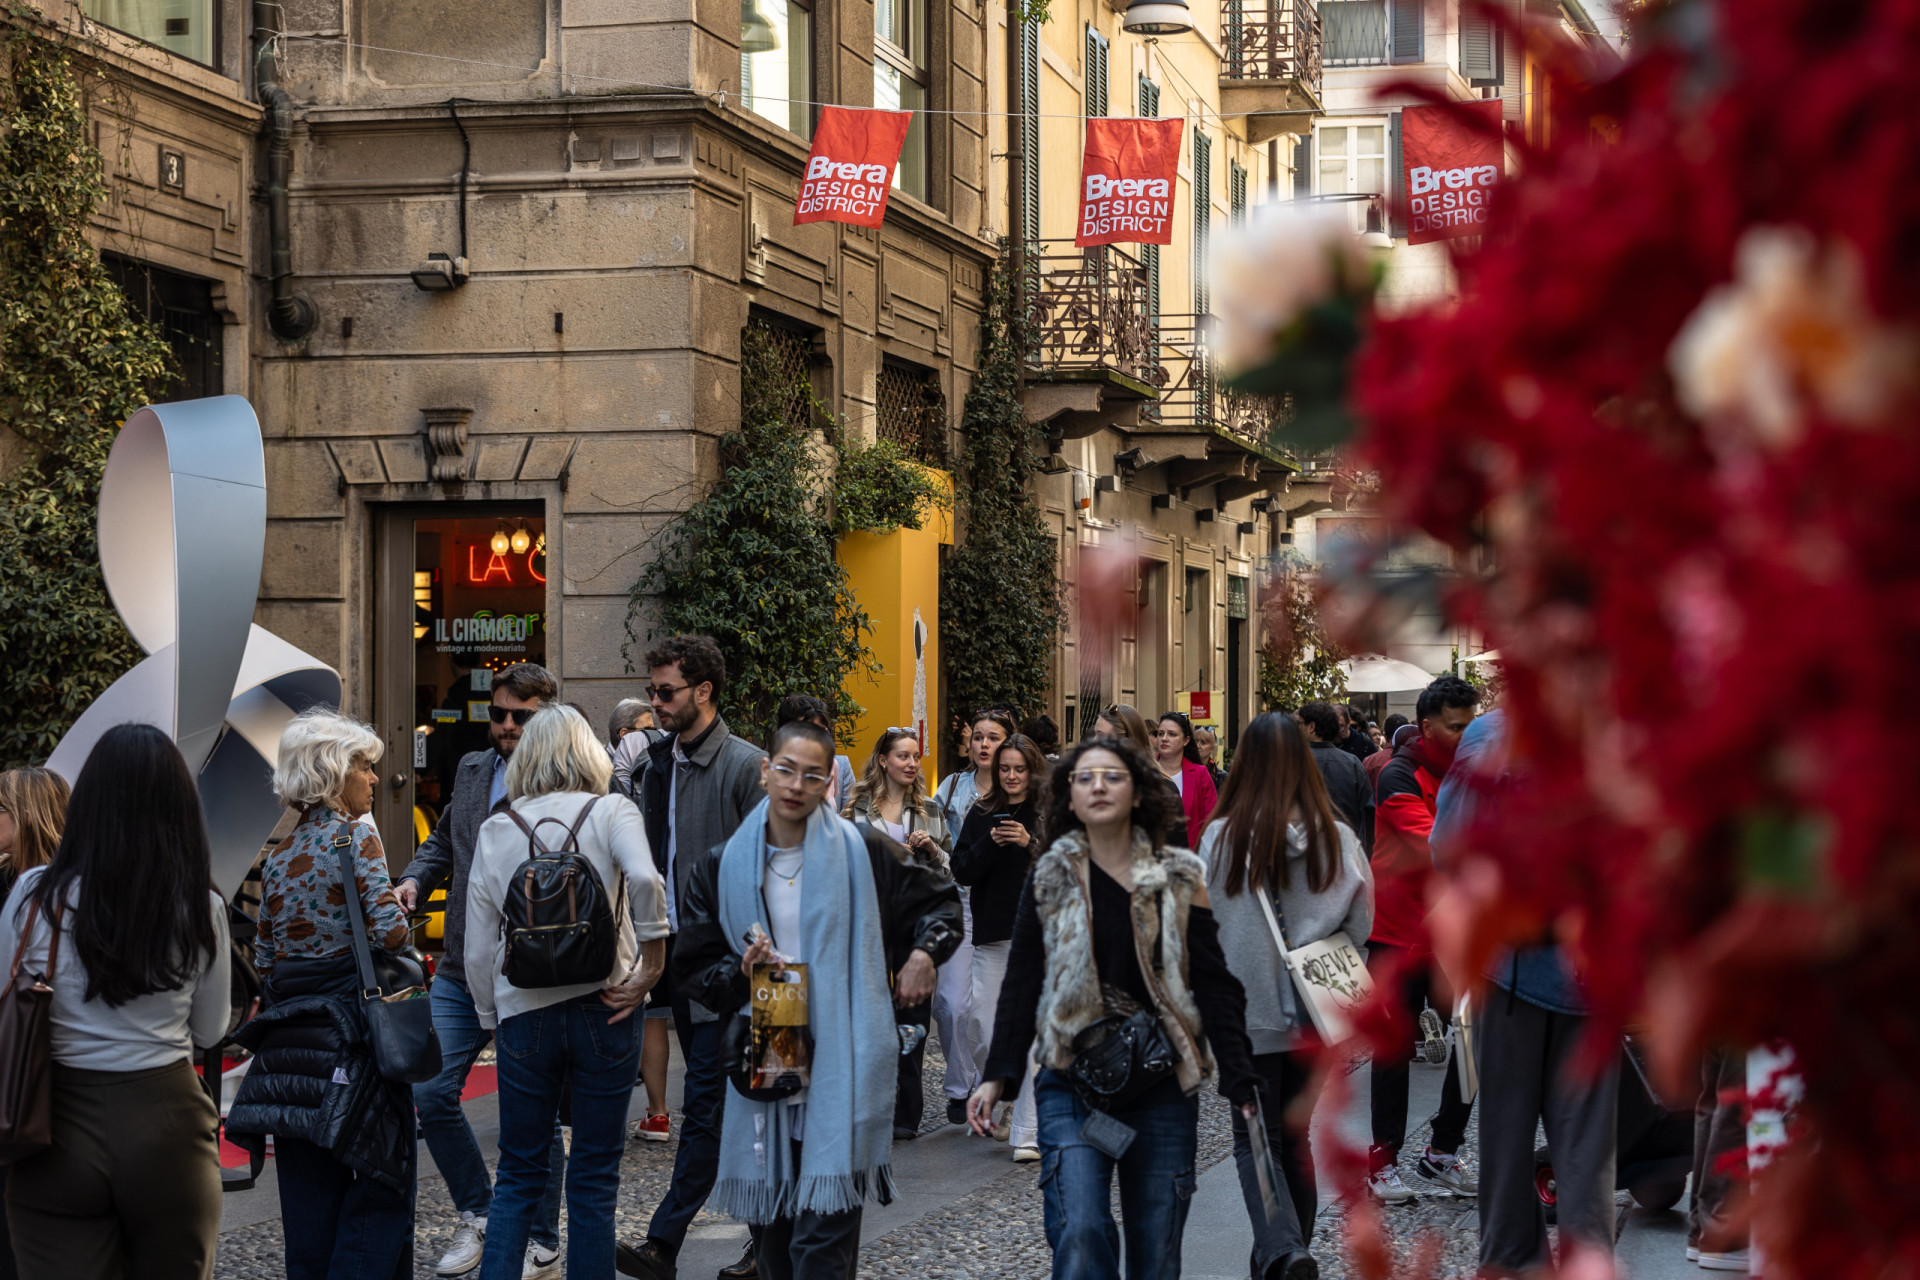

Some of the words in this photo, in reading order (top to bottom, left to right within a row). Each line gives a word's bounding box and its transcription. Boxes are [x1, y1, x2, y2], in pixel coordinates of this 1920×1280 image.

[168, 156, 178, 183] 3
[807, 156, 887, 184] Brera
[1410, 165, 1498, 195] Brera
[802, 181, 883, 201] DESIGN
[1086, 174, 1169, 201] Brera
[798, 196, 880, 216] DISTRICT
[1084, 200, 1168, 220] DESIGN
[1082, 216, 1166, 237] DISTRICT
[1414, 207, 1490, 233] DISTRIC
[469, 545, 512, 582] LA
[435, 617, 450, 642] IL
[452, 617, 526, 642] CIRMOLO
[436, 644, 465, 655] vintage
[474, 644, 526, 653] modernariato
[416, 734, 424, 764] PUSH
